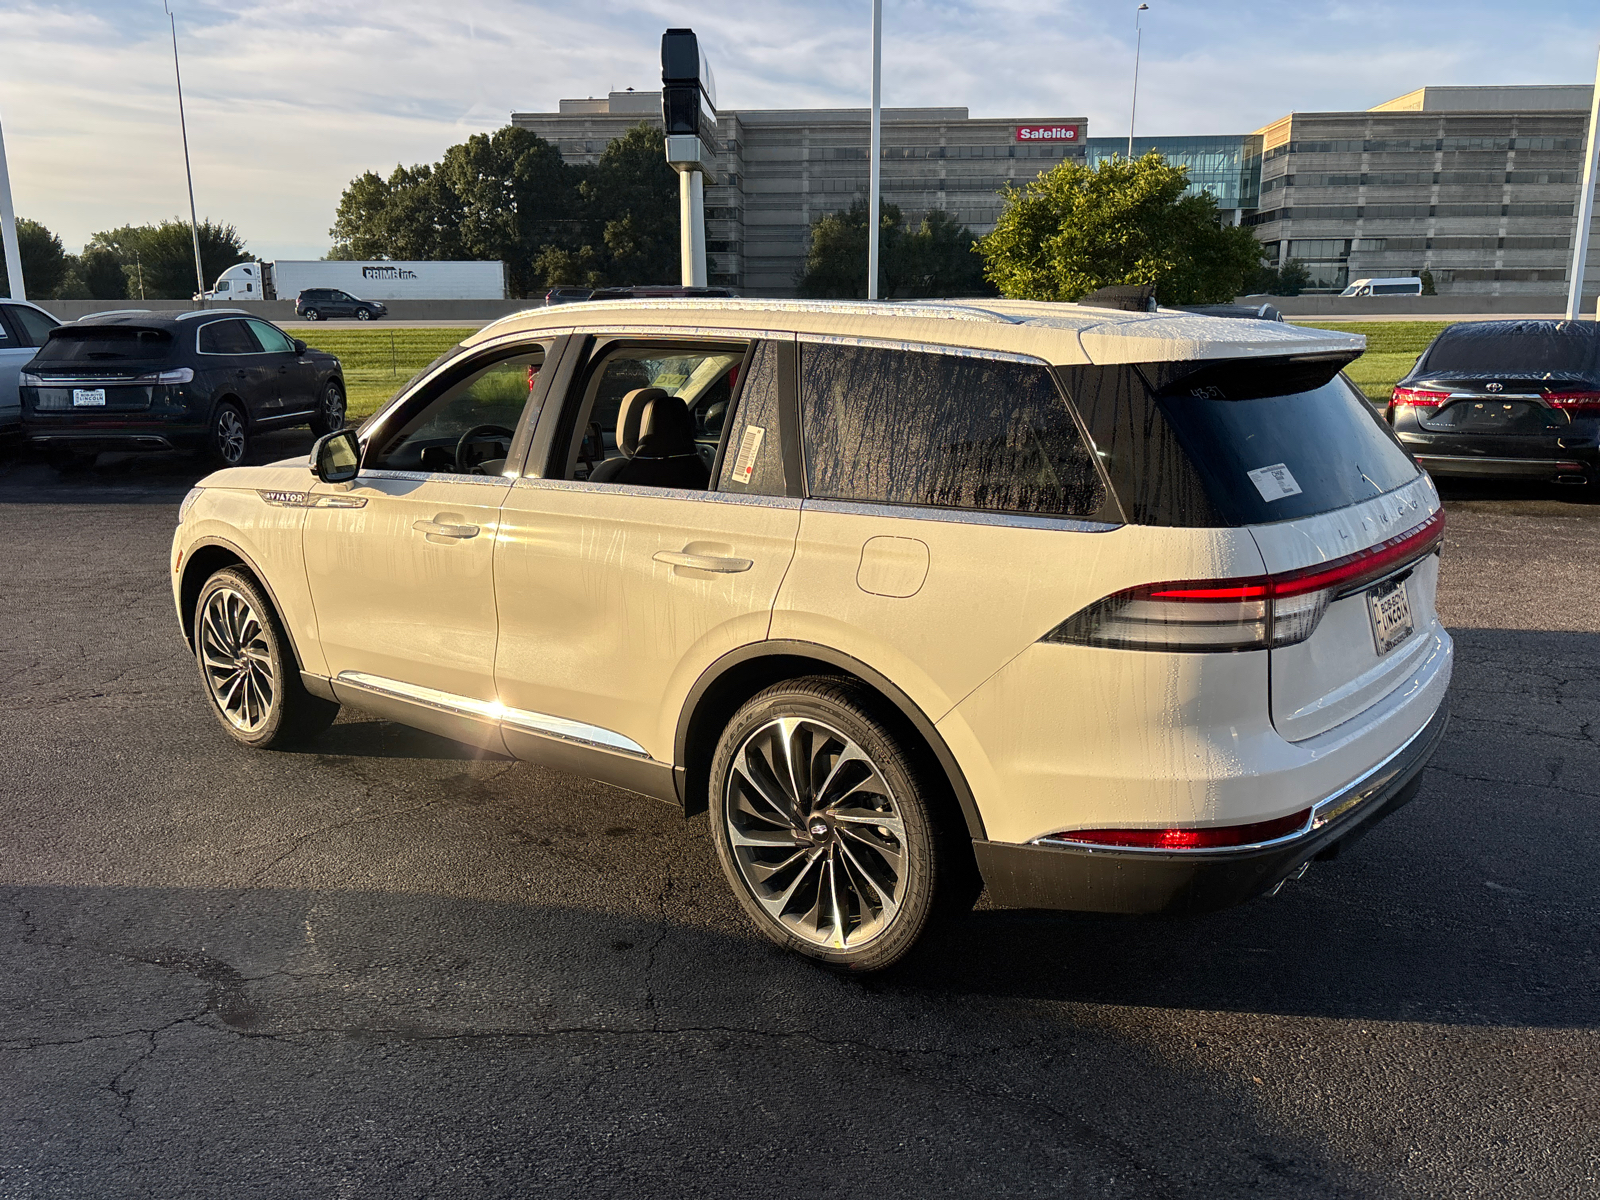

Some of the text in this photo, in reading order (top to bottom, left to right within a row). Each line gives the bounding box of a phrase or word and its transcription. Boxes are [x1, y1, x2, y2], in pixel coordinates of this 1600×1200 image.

[1020, 128, 1075, 139] Safelite
[362, 267, 398, 279] PRIME
[266, 492, 305, 502] AVIATOR
[1382, 602, 1409, 631] LINCOLN
